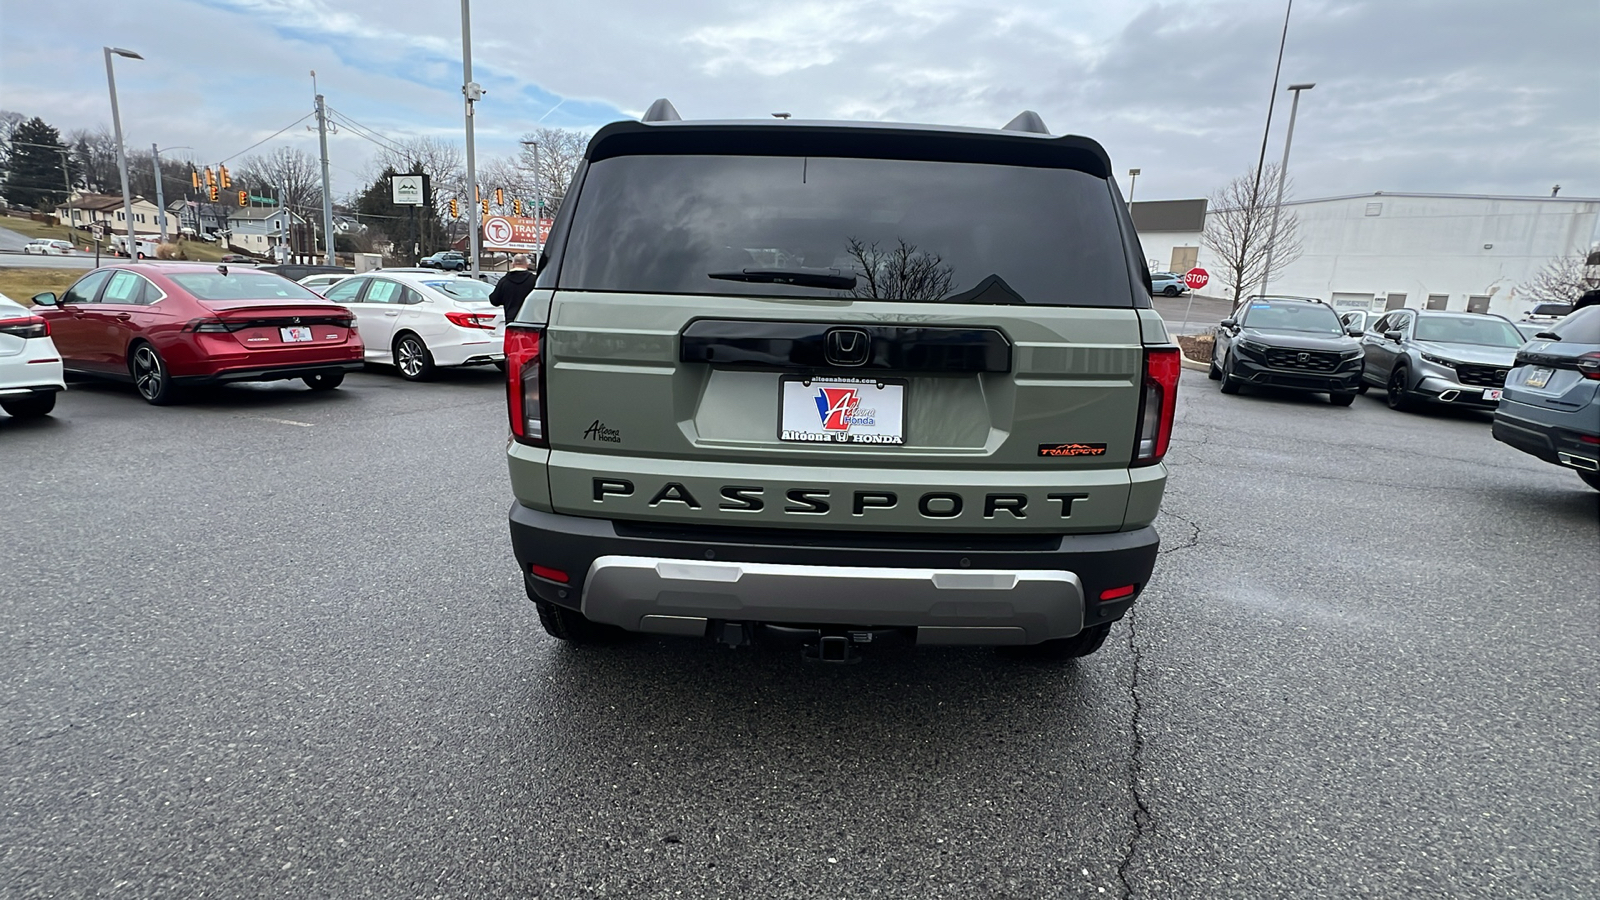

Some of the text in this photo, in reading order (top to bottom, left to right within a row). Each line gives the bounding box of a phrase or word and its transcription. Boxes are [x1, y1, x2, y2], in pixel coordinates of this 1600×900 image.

[1186, 273, 1208, 284] STOP
[811, 376, 877, 384] altoonahonda.com
[823, 392, 875, 425] Altoona
[844, 416, 874, 425] Honda
[583, 419, 620, 441] Altoona
[598, 433, 621, 443] Honda
[781, 430, 832, 441] Altoona
[852, 433, 903, 444] HONDA
[1041, 448, 1105, 456] TRAILSPORT
[592, 476, 1090, 520] PASSPORT
